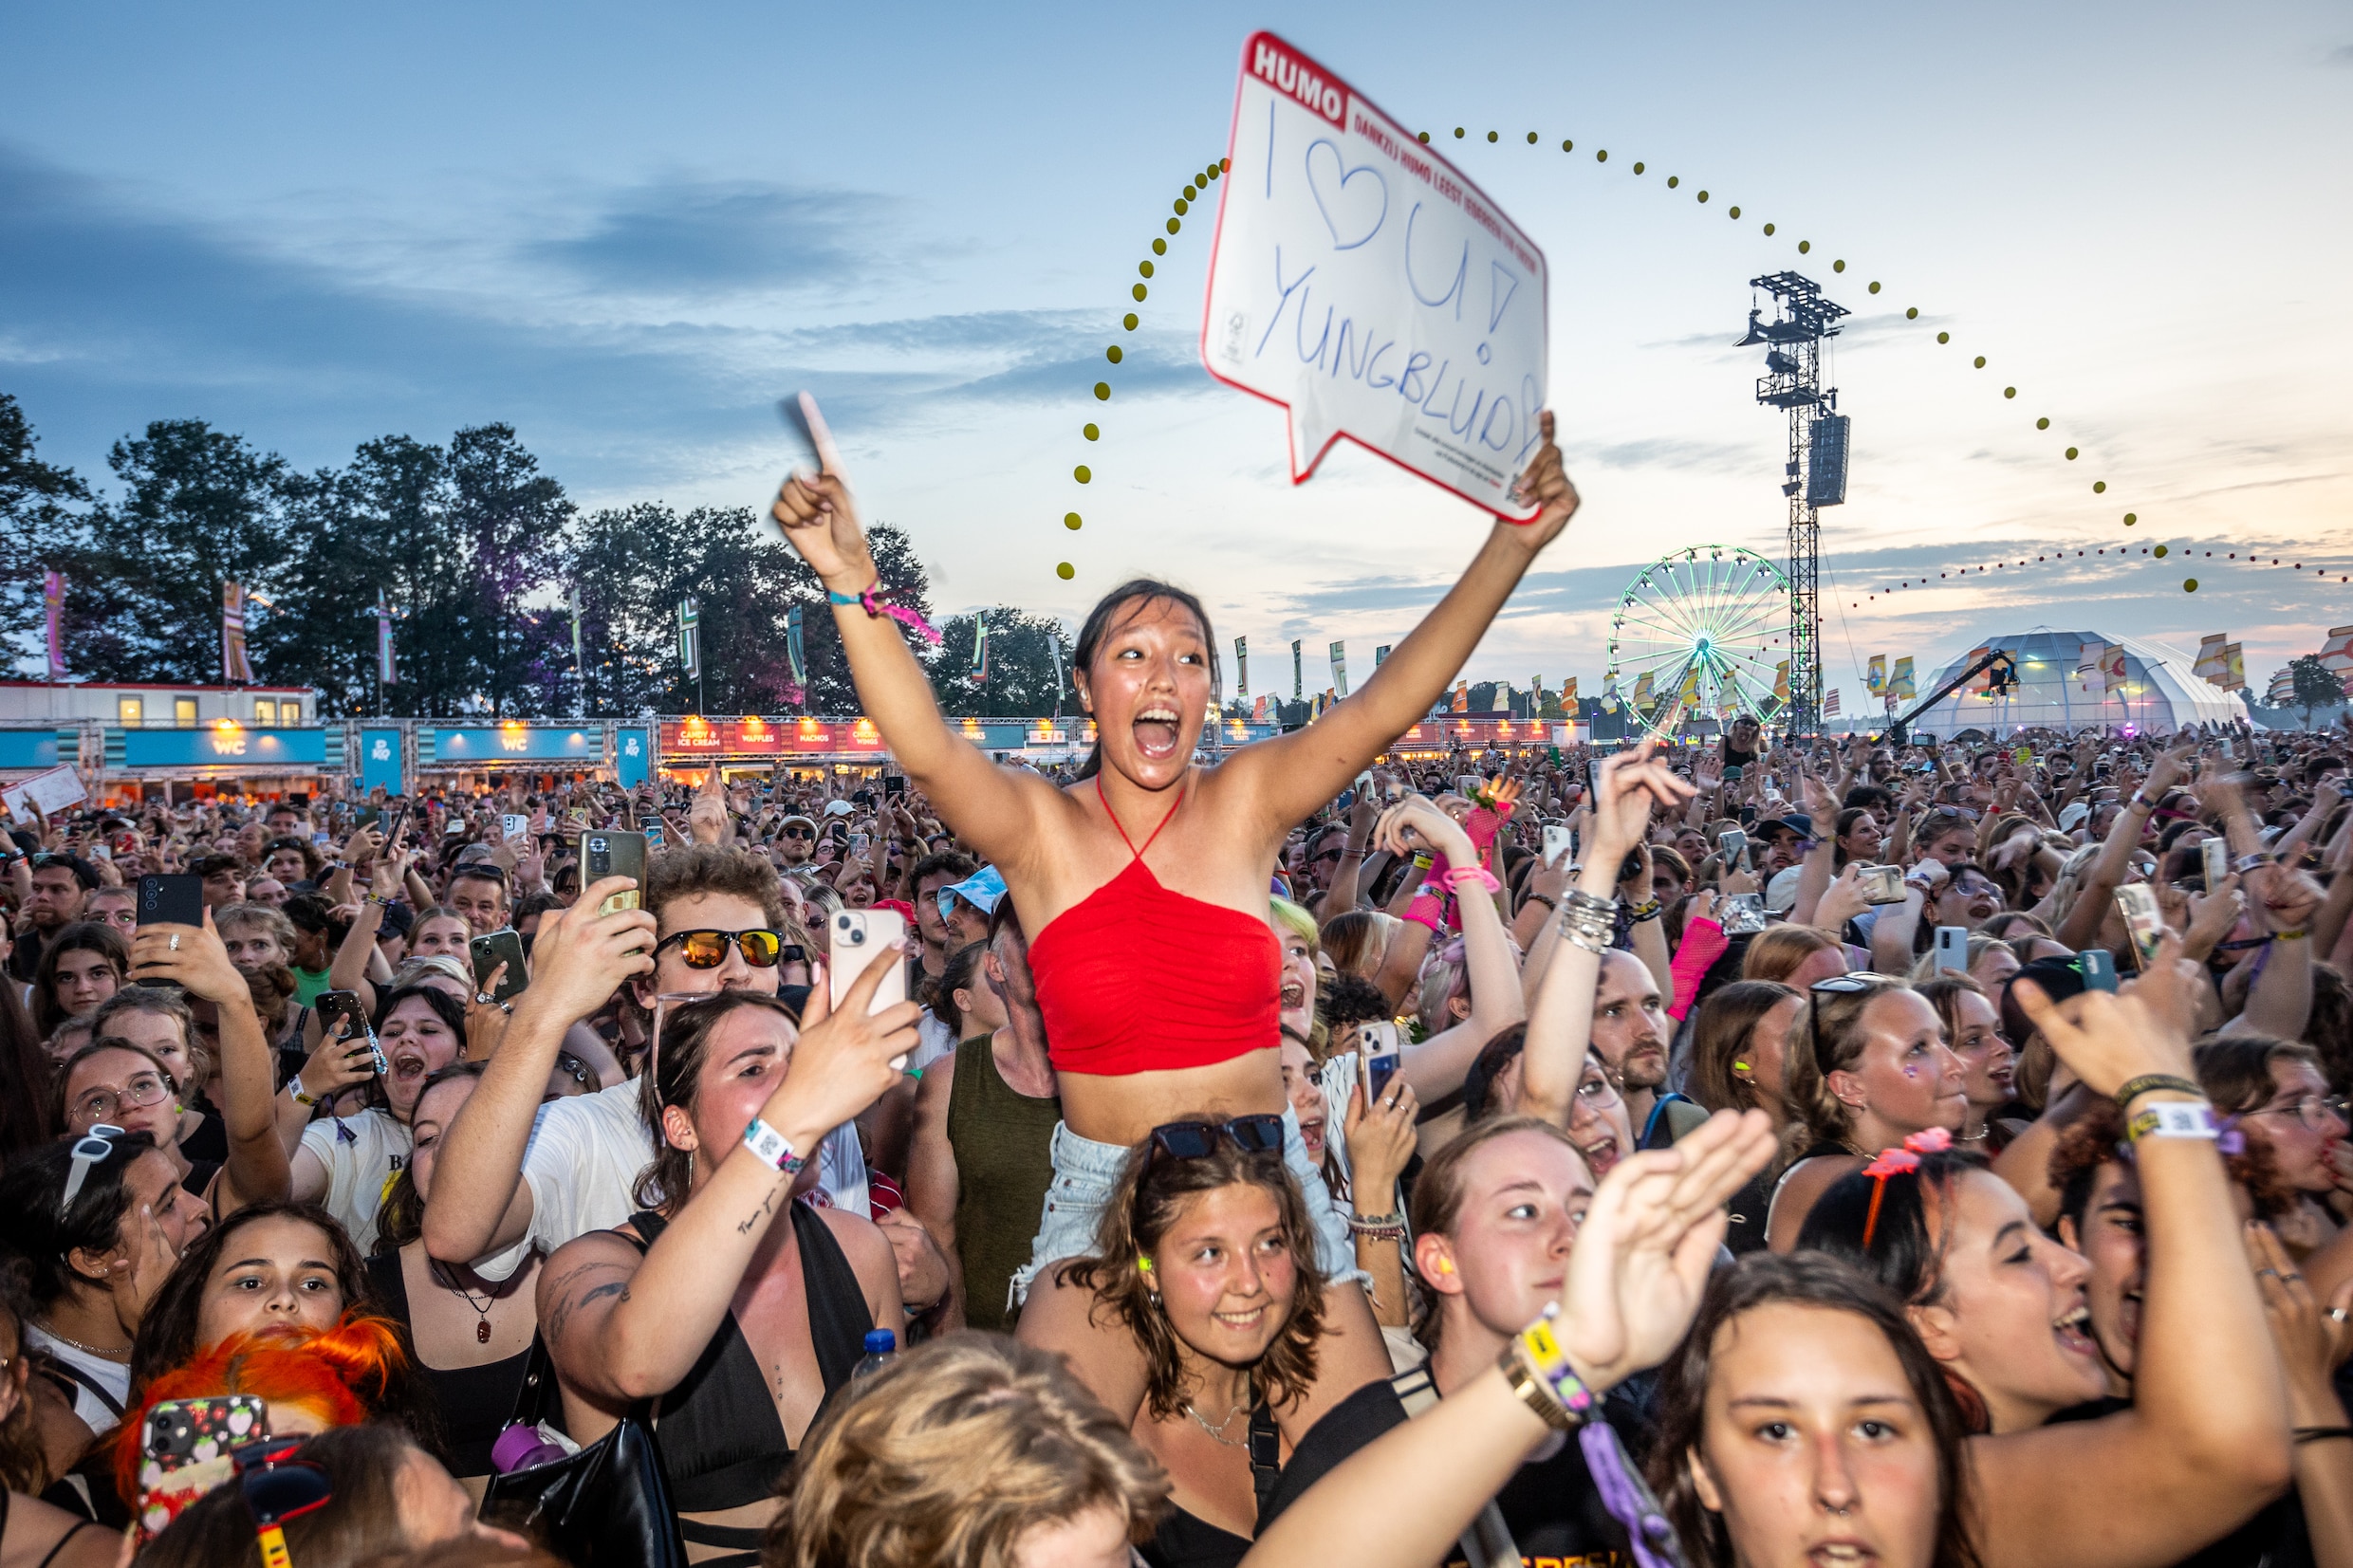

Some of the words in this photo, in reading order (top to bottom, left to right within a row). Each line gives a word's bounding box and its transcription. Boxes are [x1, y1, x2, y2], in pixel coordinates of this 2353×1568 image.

[1253, 42, 1343, 122] HUMO
[1266, 98, 1275, 200] I
[1354, 113, 1399, 162] DANKZIJ
[1399, 146, 1433, 185] HUMO
[1433, 167, 1464, 208] LEEST
[213, 740, 247, 755] WC
[502, 738, 528, 751] WC
[680, 730, 708, 739] CANDY
